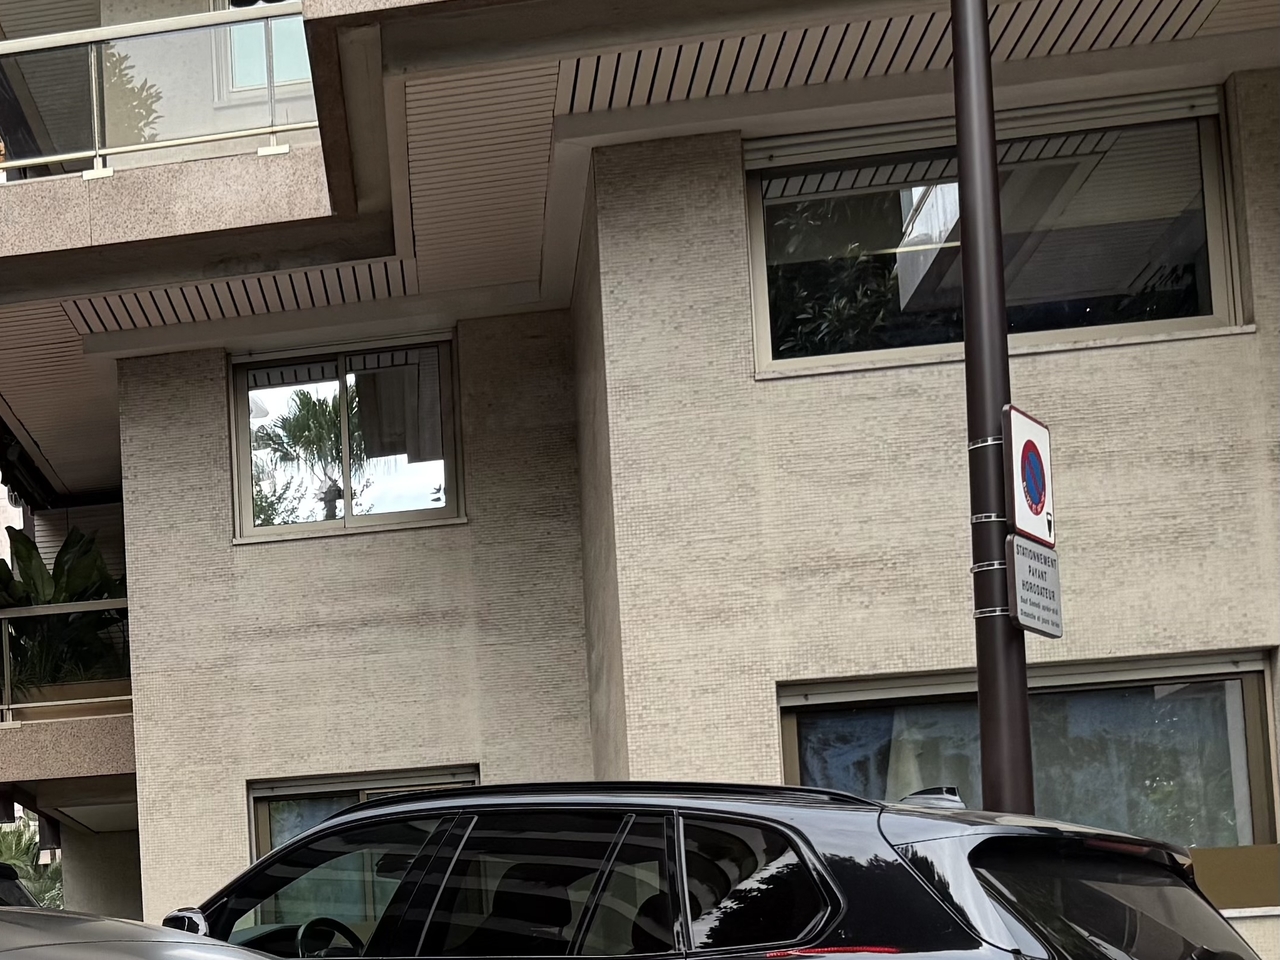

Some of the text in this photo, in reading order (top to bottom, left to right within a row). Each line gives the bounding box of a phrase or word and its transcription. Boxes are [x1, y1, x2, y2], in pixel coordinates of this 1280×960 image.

[1016, 543, 1057, 570] STATIONNEMENT
[1028, 565, 1047, 582] PAYANT
[1022, 579, 1056, 602] HORODATEUR
